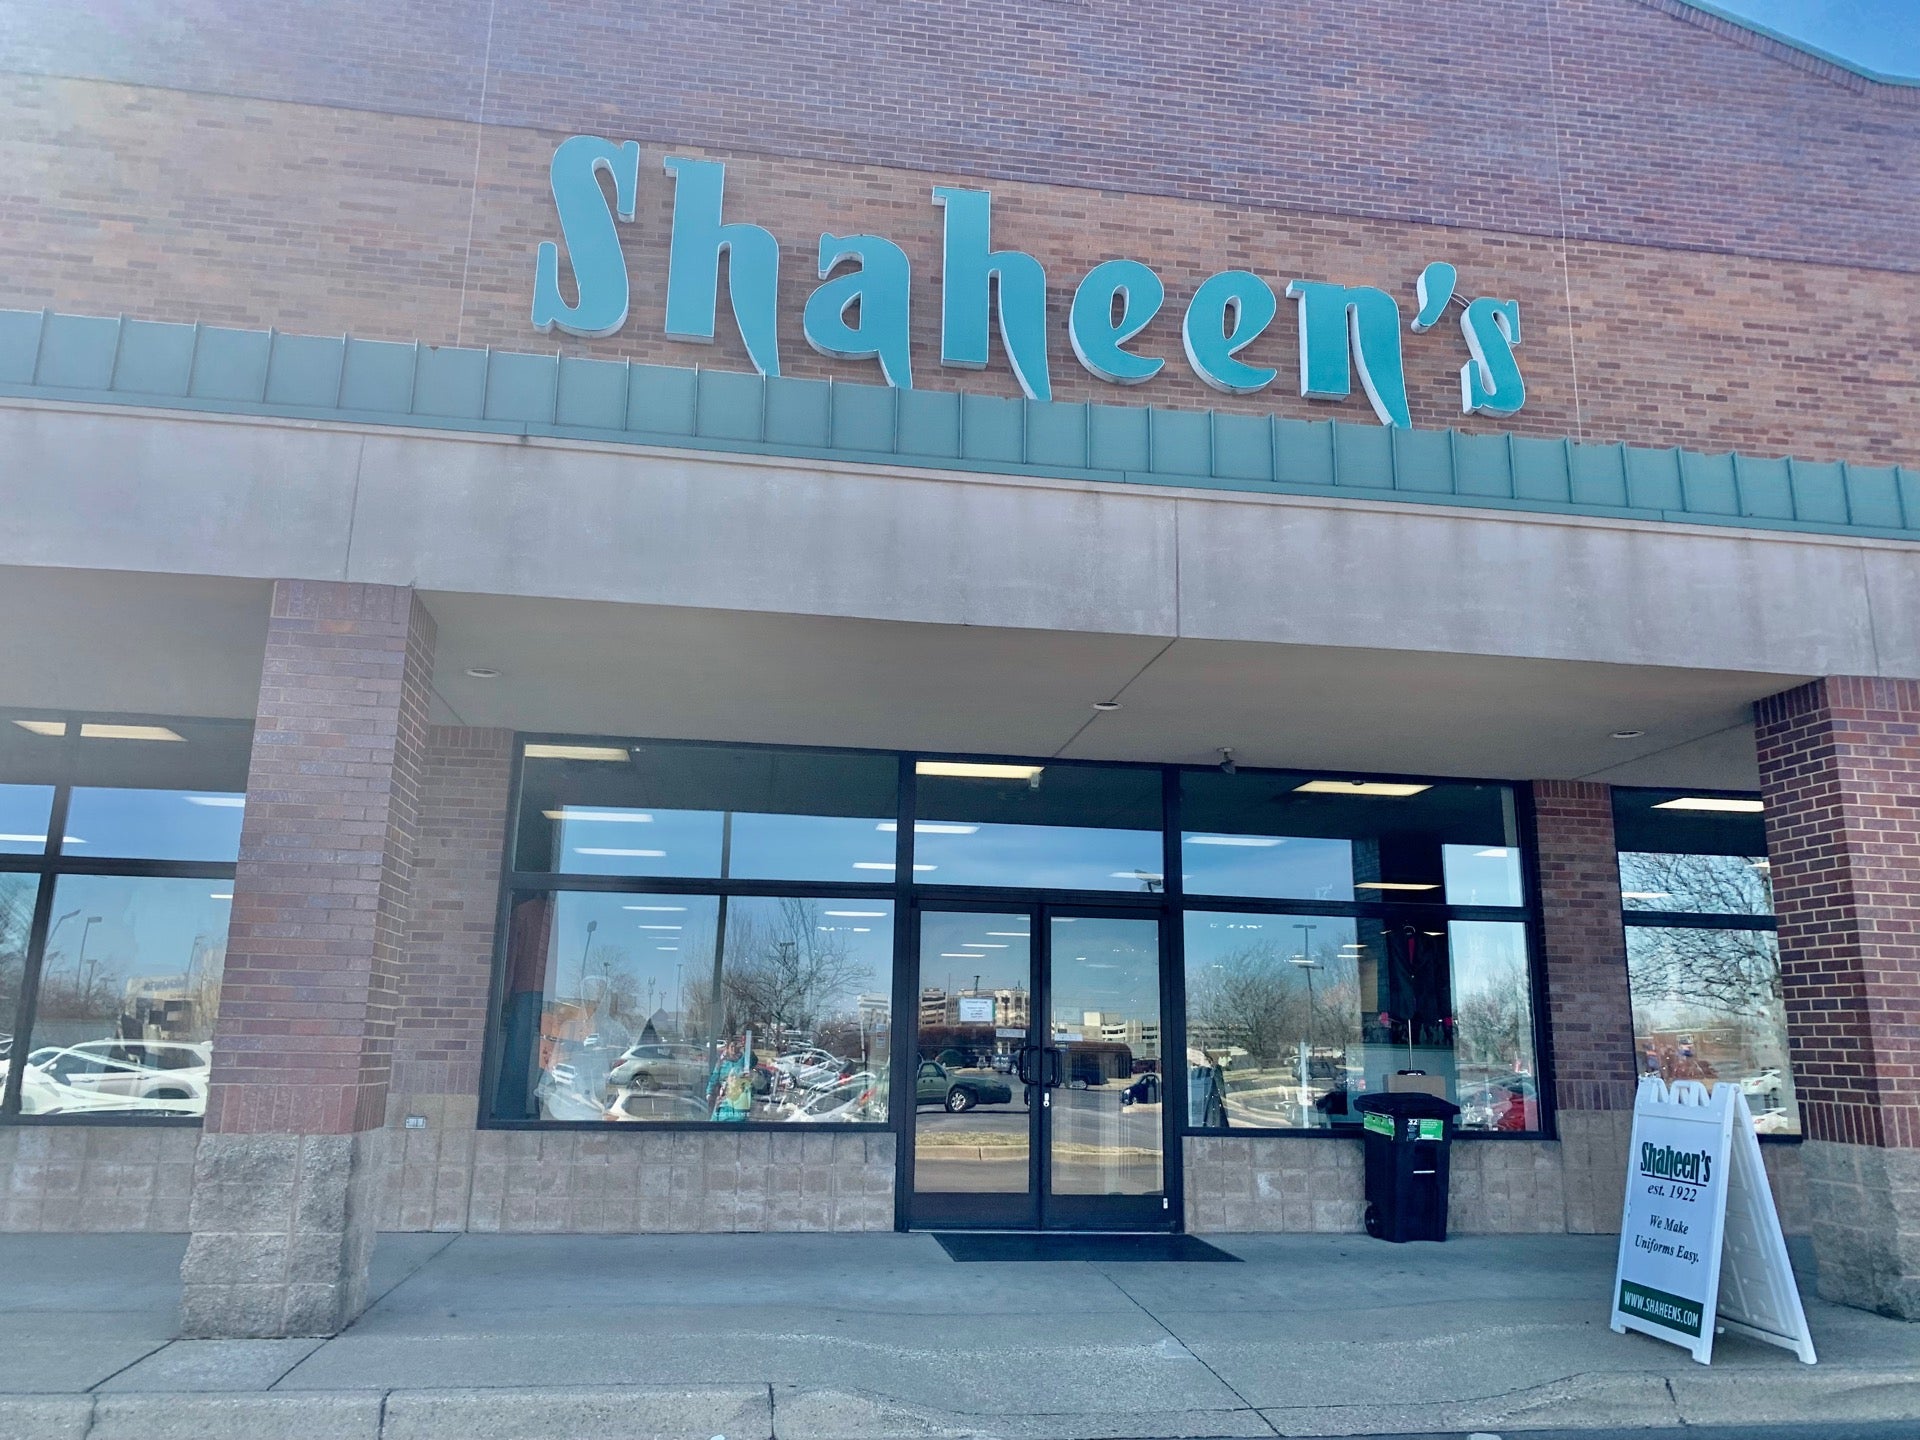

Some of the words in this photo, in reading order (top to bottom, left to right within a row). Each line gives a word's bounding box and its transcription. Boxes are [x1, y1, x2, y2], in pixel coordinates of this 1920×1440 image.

[531, 134, 1526, 428] Shaheen's
[1640, 1141, 1711, 1184] Shaheen's
[1647, 1184, 1665, 1196] est.
[1669, 1185, 1697, 1202] 1922
[1649, 1214, 1663, 1229] We
[1663, 1218, 1689, 1235] Make
[1635, 1234, 1675, 1256] Uniforms
[1676, 1245, 1699, 1265] Easy.
[1624, 1291, 1699, 1329] WWW.SHAHEENS.COM
